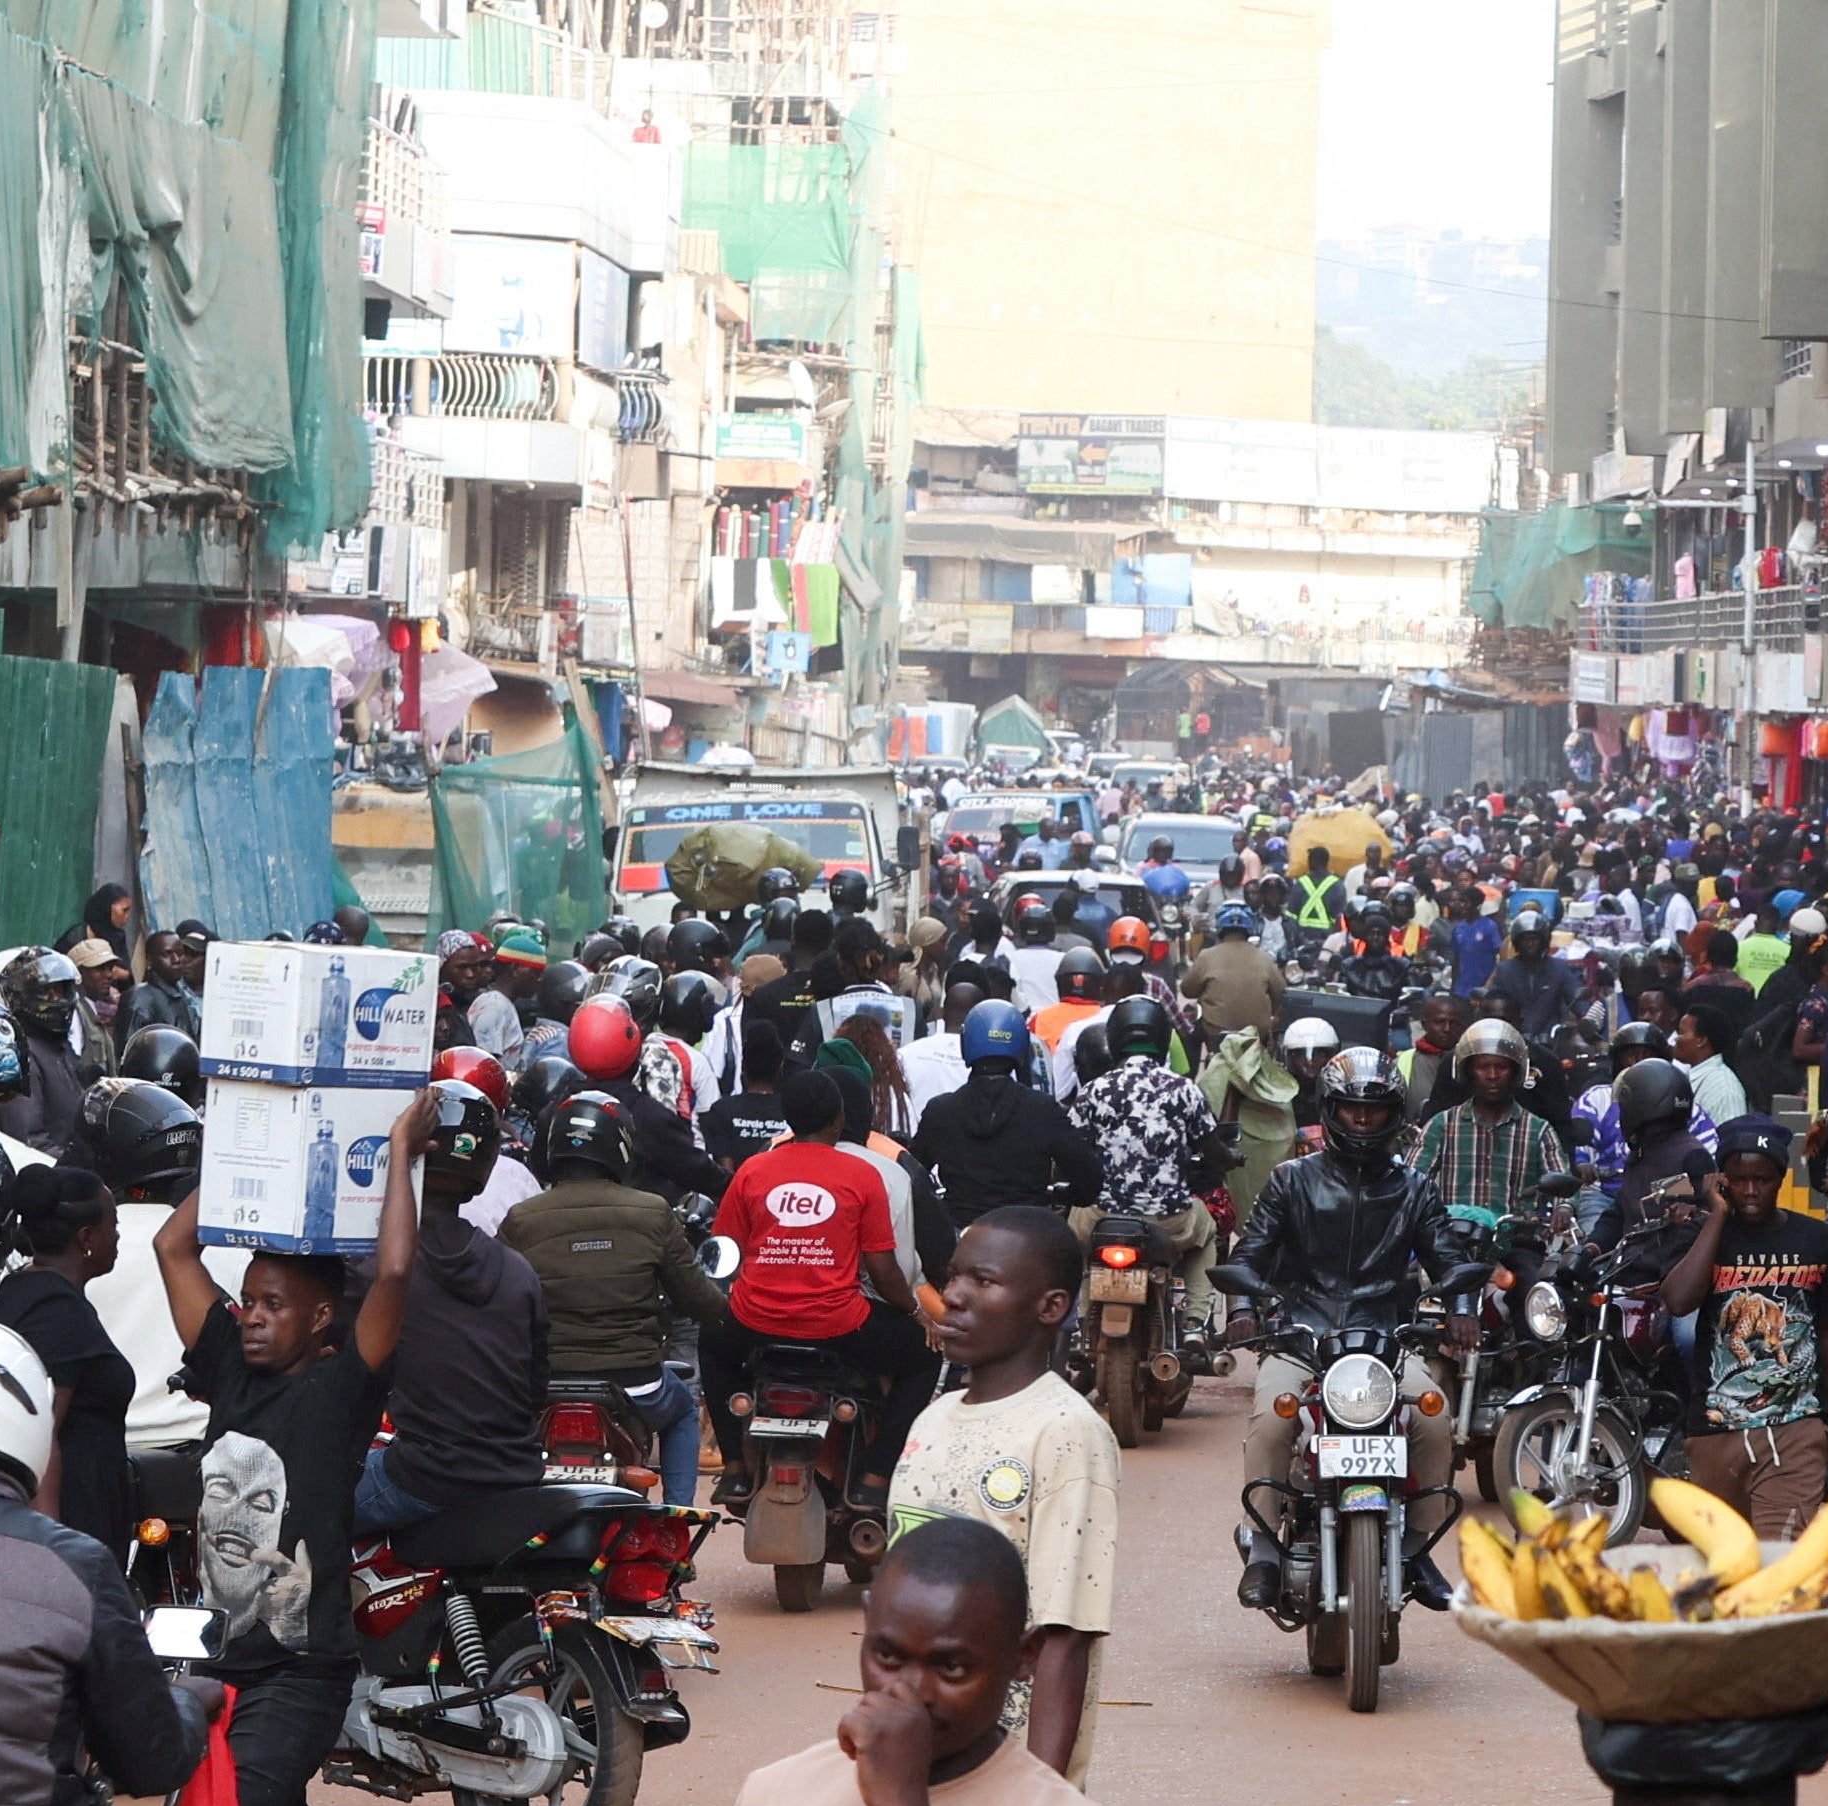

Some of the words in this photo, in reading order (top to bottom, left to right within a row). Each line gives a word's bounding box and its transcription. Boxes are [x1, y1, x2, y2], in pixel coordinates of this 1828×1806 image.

[666, 806, 731, 820] ONE
[744, 803, 823, 819] LOVE
[354, 1007, 381, 1022] HILL
[384, 1008, 425, 1025] WATER
[217, 1064, 230, 1075] 24
[238, 1067, 258, 1079] 500
[1757, 1136, 1769, 1149] K
[347, 1154, 372, 1170] HILL
[780, 1191, 822, 1215] itel
[767, 1237, 781, 1245] The
[783, 1238, 812, 1246] master
[814, 1237, 825, 1246] of
[791, 1246, 797, 1255] &
[798, 1257, 834, 1266] Products
[1737, 1255, 1799, 1265] SAVAGE
[1352, 1438, 1397, 1454] UFX
[1341, 1457, 1397, 1475] 997X
